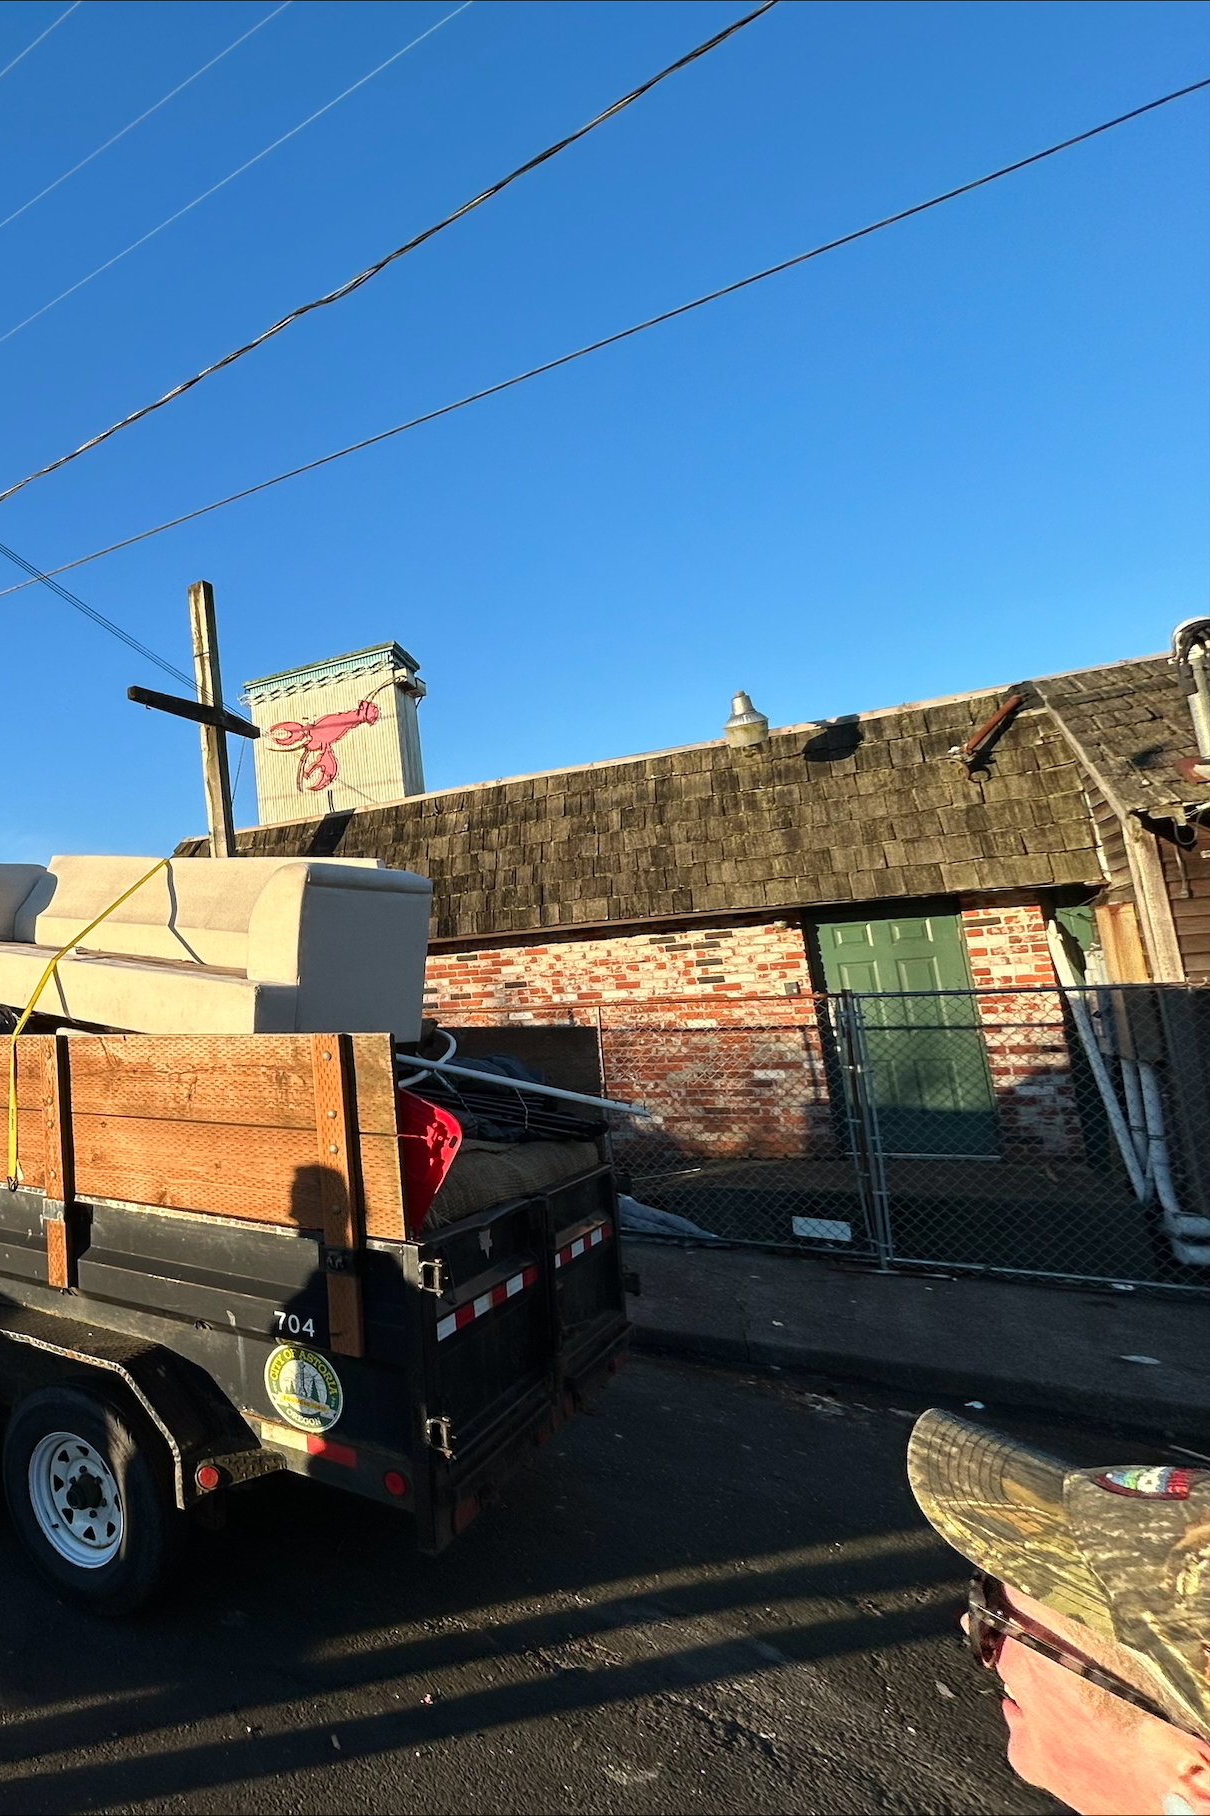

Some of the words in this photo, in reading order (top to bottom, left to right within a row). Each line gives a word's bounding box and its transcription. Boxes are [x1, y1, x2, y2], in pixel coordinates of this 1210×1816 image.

[273, 1310, 315, 1338] 704
[270, 1354, 285, 1380] CITY
[283, 1348, 296, 1360] OF
[299, 1350, 338, 1395] ASTORIA
[286, 1408, 321, 1425] OREGON
